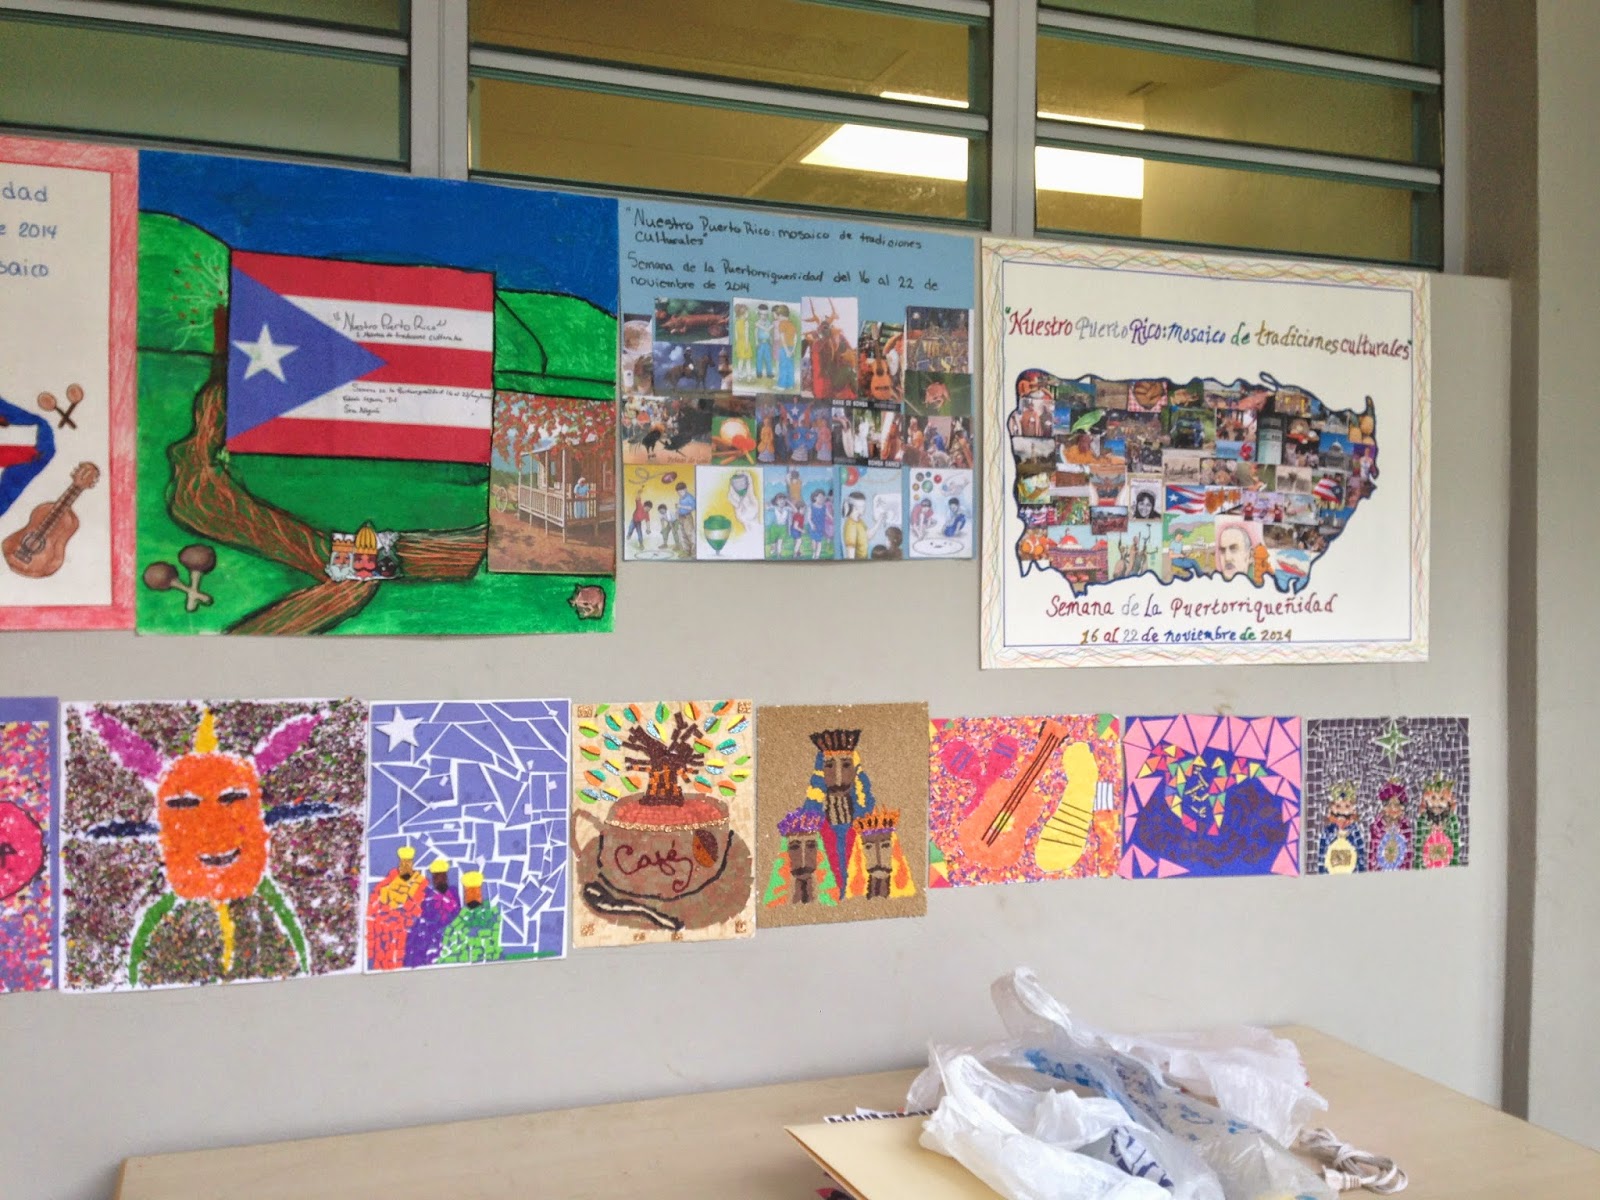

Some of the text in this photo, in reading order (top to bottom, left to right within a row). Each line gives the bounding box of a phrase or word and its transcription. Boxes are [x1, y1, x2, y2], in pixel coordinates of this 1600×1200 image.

[19, 222, 57, 239] 2014
[700, 216, 741, 233] Puerto
[839, 231, 853, 240] de
[628, 251, 673, 268] Semana
[683, 262, 696, 272] de
[704, 262, 715, 272] la
[833, 271, 851, 283] del
[859, 270, 870, 284] 16
[878, 275, 890, 286] al
[898, 276, 914, 289] 22
[924, 278, 939, 291] de
[631, 276, 750, 293] noviembre de 2014
[381, 313, 411, 331] Puerto
[1075, 316, 1129, 341] Puerto
[1230, 321, 1251, 346] de
[1046, 594, 1115, 618] Semana
[1121, 593, 1139, 617] de
[1170, 592, 1338, 623] Puertorriqueñidad
[1080, 628, 1100, 645] 16
[1123, 628, 1139, 643] 22
[1141, 626, 1159, 643] de
[1164, 625, 1237, 643] noviembre
[1239, 626, 1257, 641] de
[1260, 628, 1293, 643] 2014
[615, 839, 693, 894] Café
